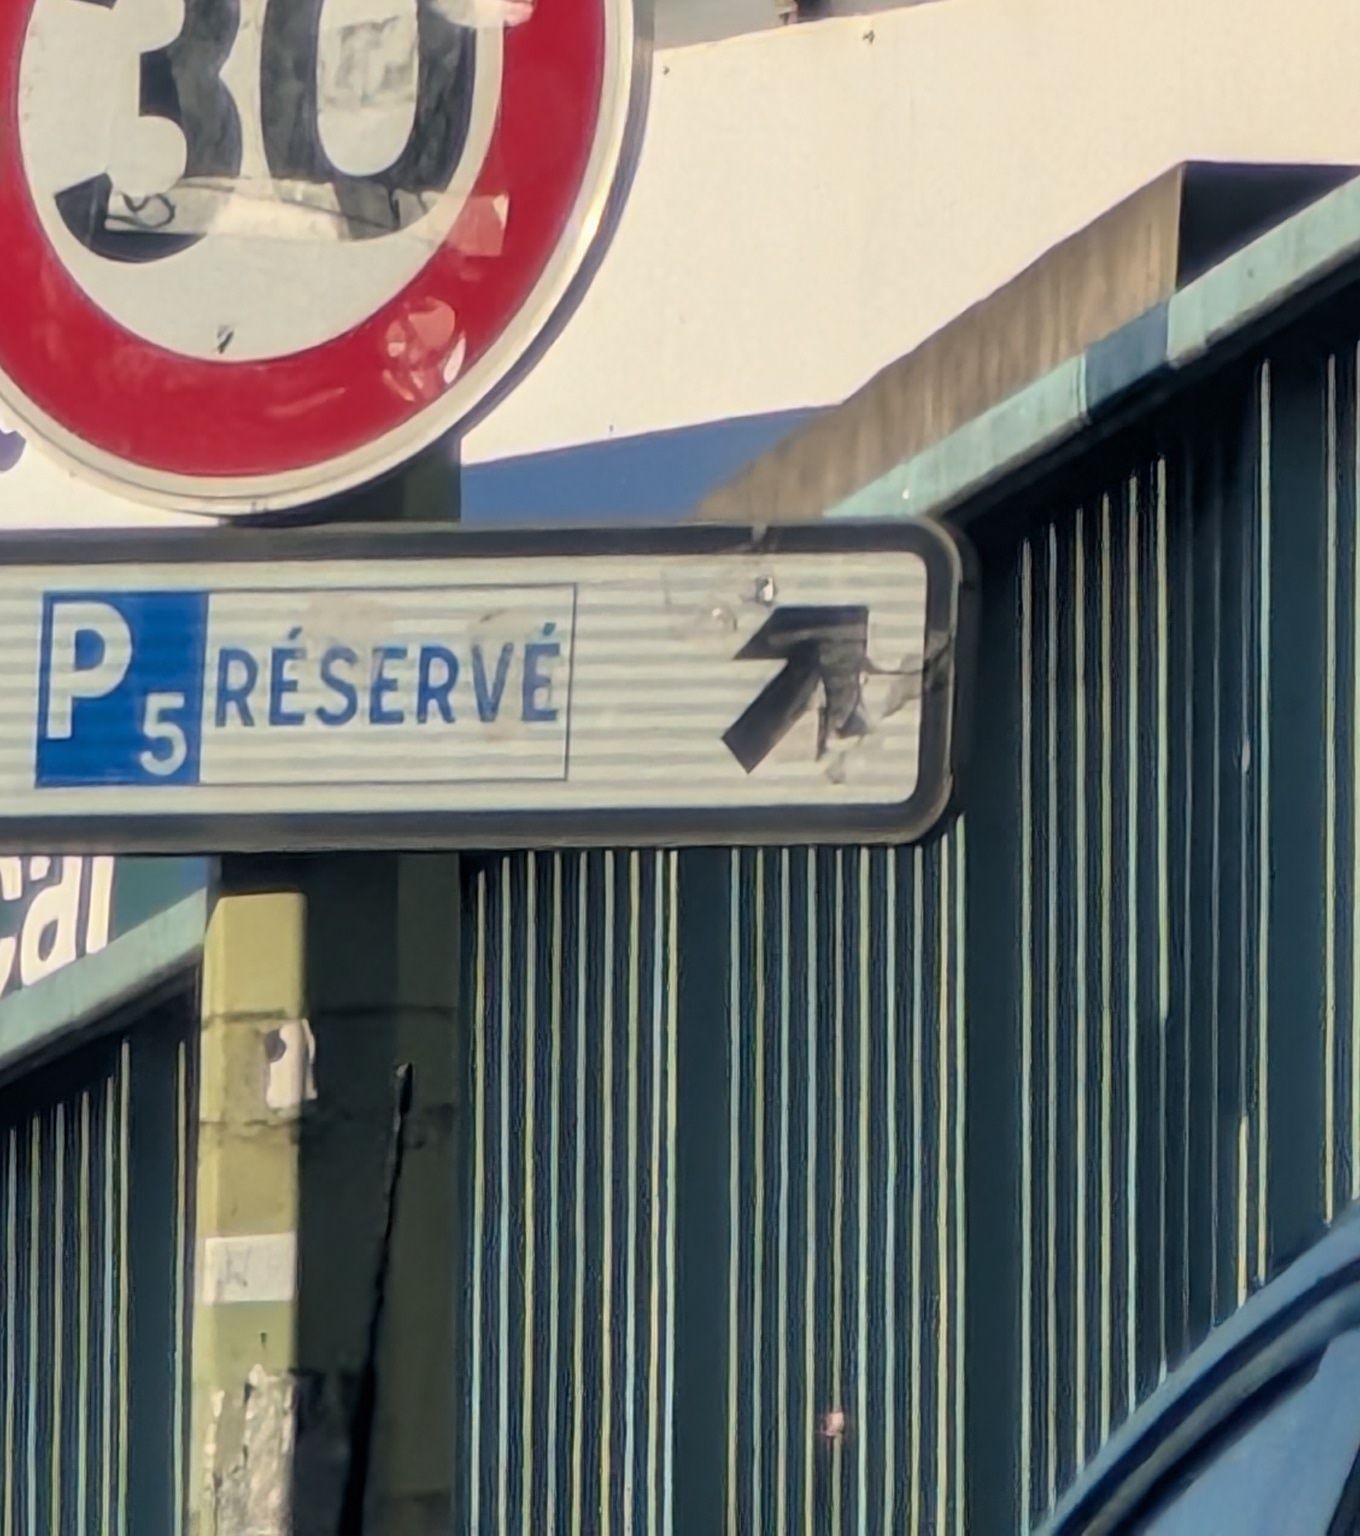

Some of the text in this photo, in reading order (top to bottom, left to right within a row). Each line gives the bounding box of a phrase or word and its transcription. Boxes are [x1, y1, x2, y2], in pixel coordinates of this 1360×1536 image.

[45, 601, 561, 777] P 5 RÉSERVÉ
